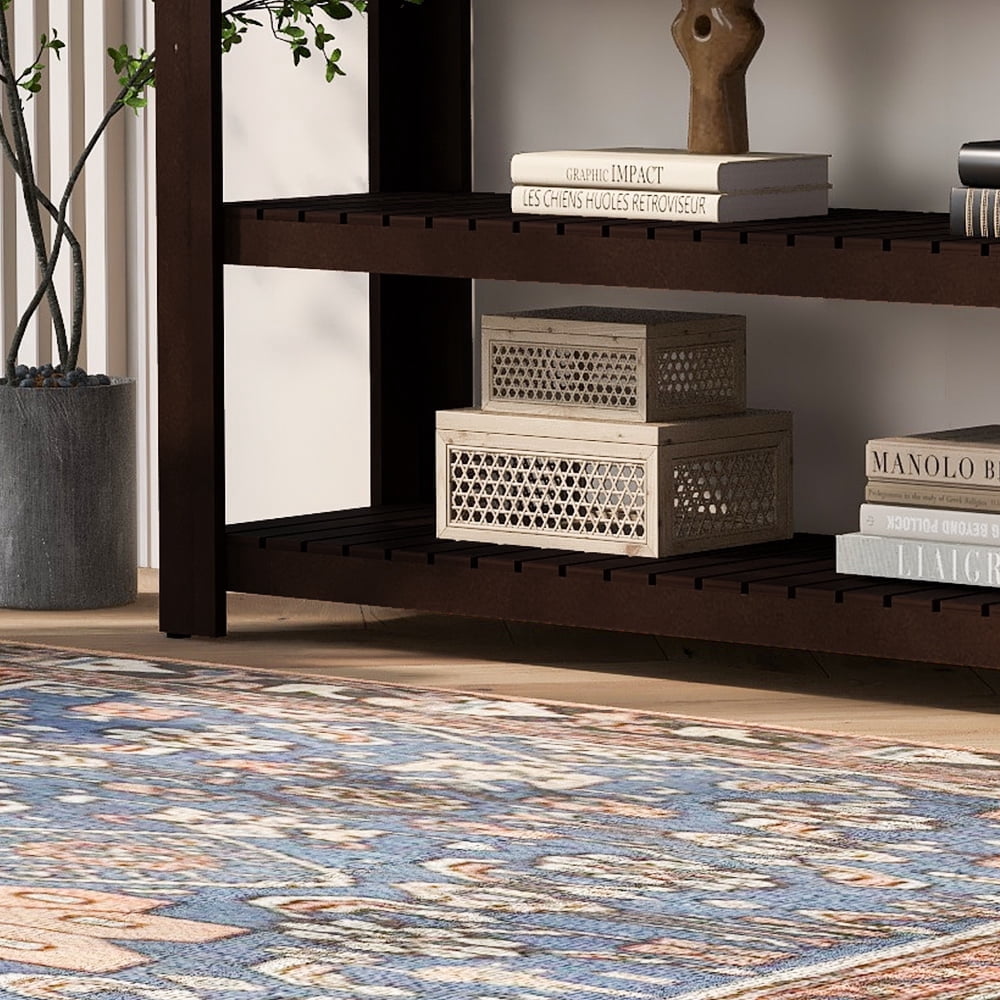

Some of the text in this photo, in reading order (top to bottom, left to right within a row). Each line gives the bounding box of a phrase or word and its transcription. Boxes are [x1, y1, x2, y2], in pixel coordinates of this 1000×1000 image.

[566, 164, 664, 184] GRAPHIC IMPACT
[523, 189, 706, 215] LES CHIENS HUOLES RETROVISEUR
[872, 450, 974, 480] MANOLO
[886, 515, 939, 534] POLLOCK
[942, 519, 988, 538] BEYOND
